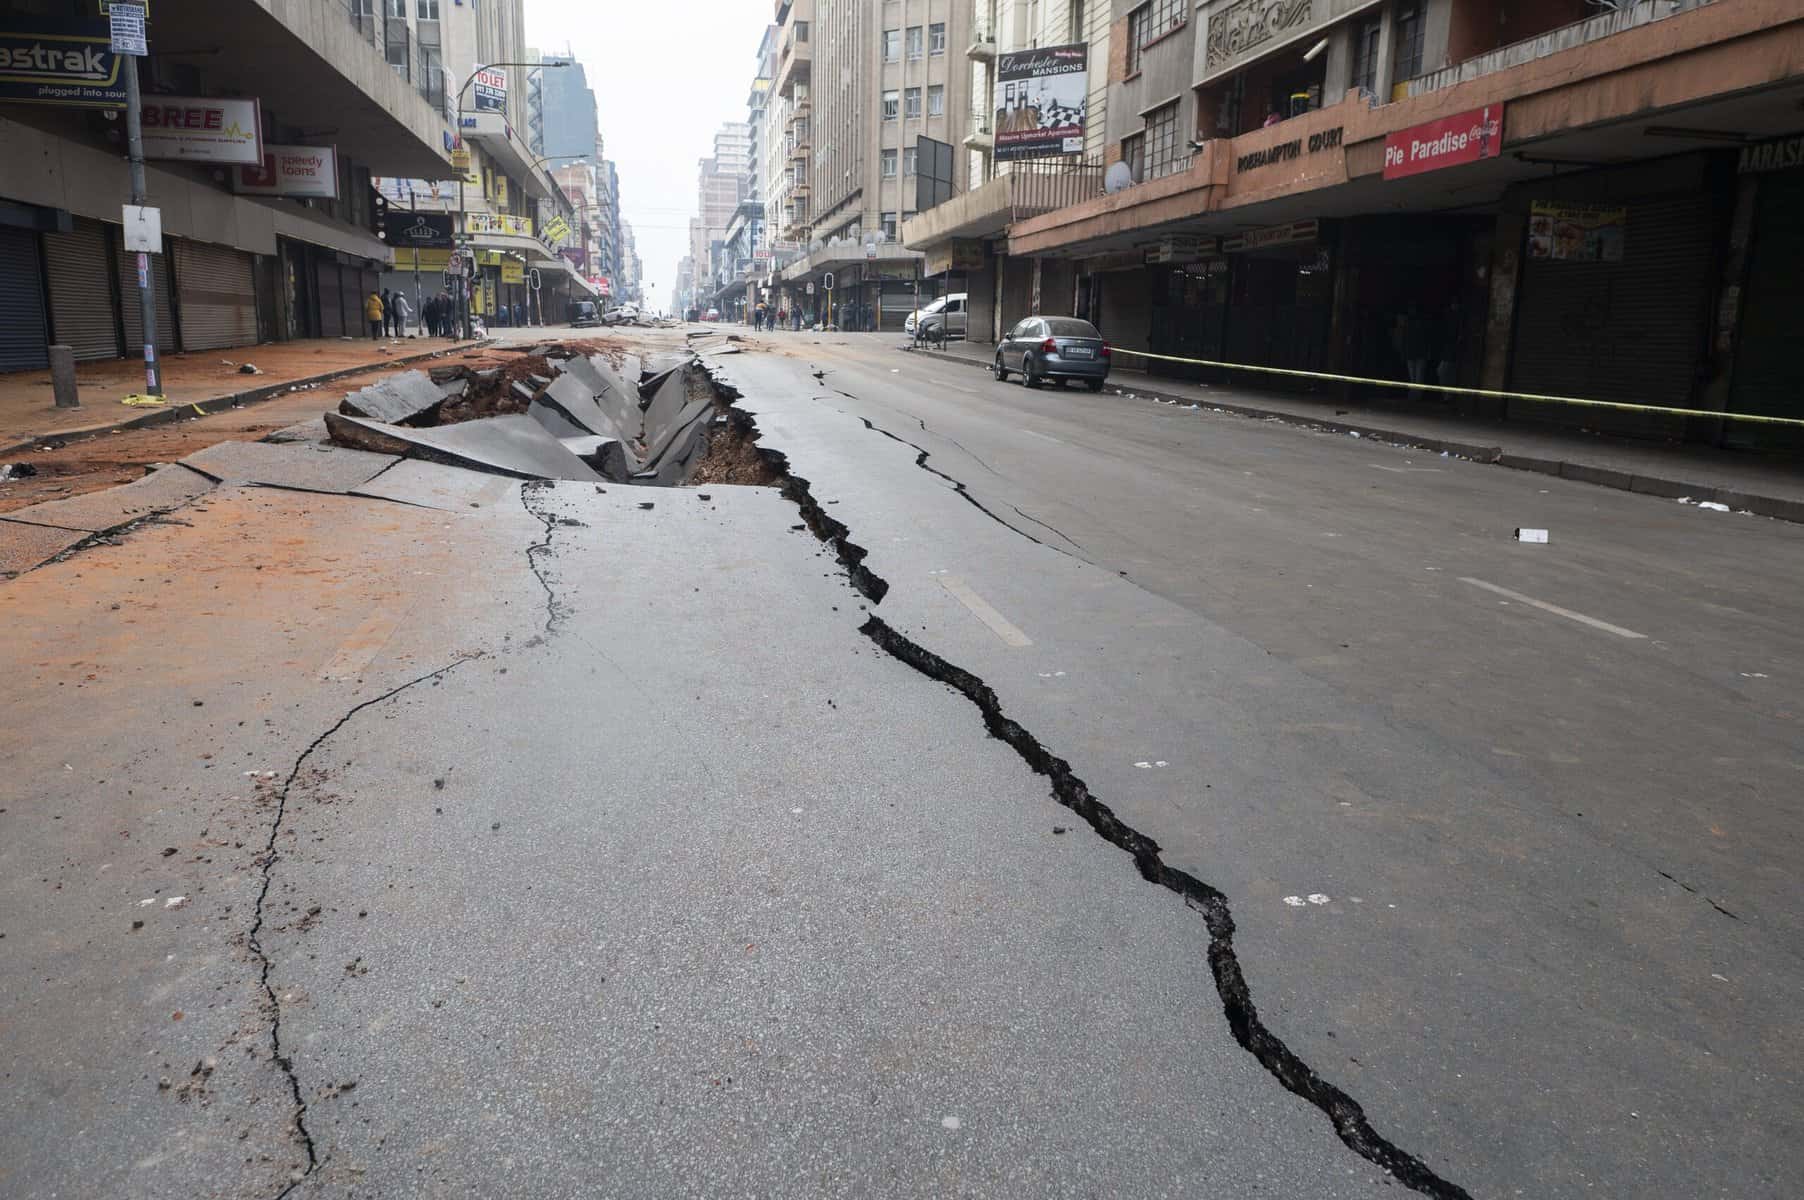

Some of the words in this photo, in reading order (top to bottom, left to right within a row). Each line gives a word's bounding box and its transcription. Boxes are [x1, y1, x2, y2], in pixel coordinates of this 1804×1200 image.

[1032, 63, 1082, 76] MANSIONS
[477, 72, 488, 84] TO
[489, 74, 504, 88] LET
[38, 86, 80, 97] plugged
[83, 87, 102, 96] into
[142, 105, 224, 129] BREE
[1308, 126, 1344, 153] COURT
[1385, 145, 1404, 168] Pie
[1411, 131, 1467, 161] Paradise
[280, 155, 322, 169] speedy
[281, 165, 316, 177] loans
